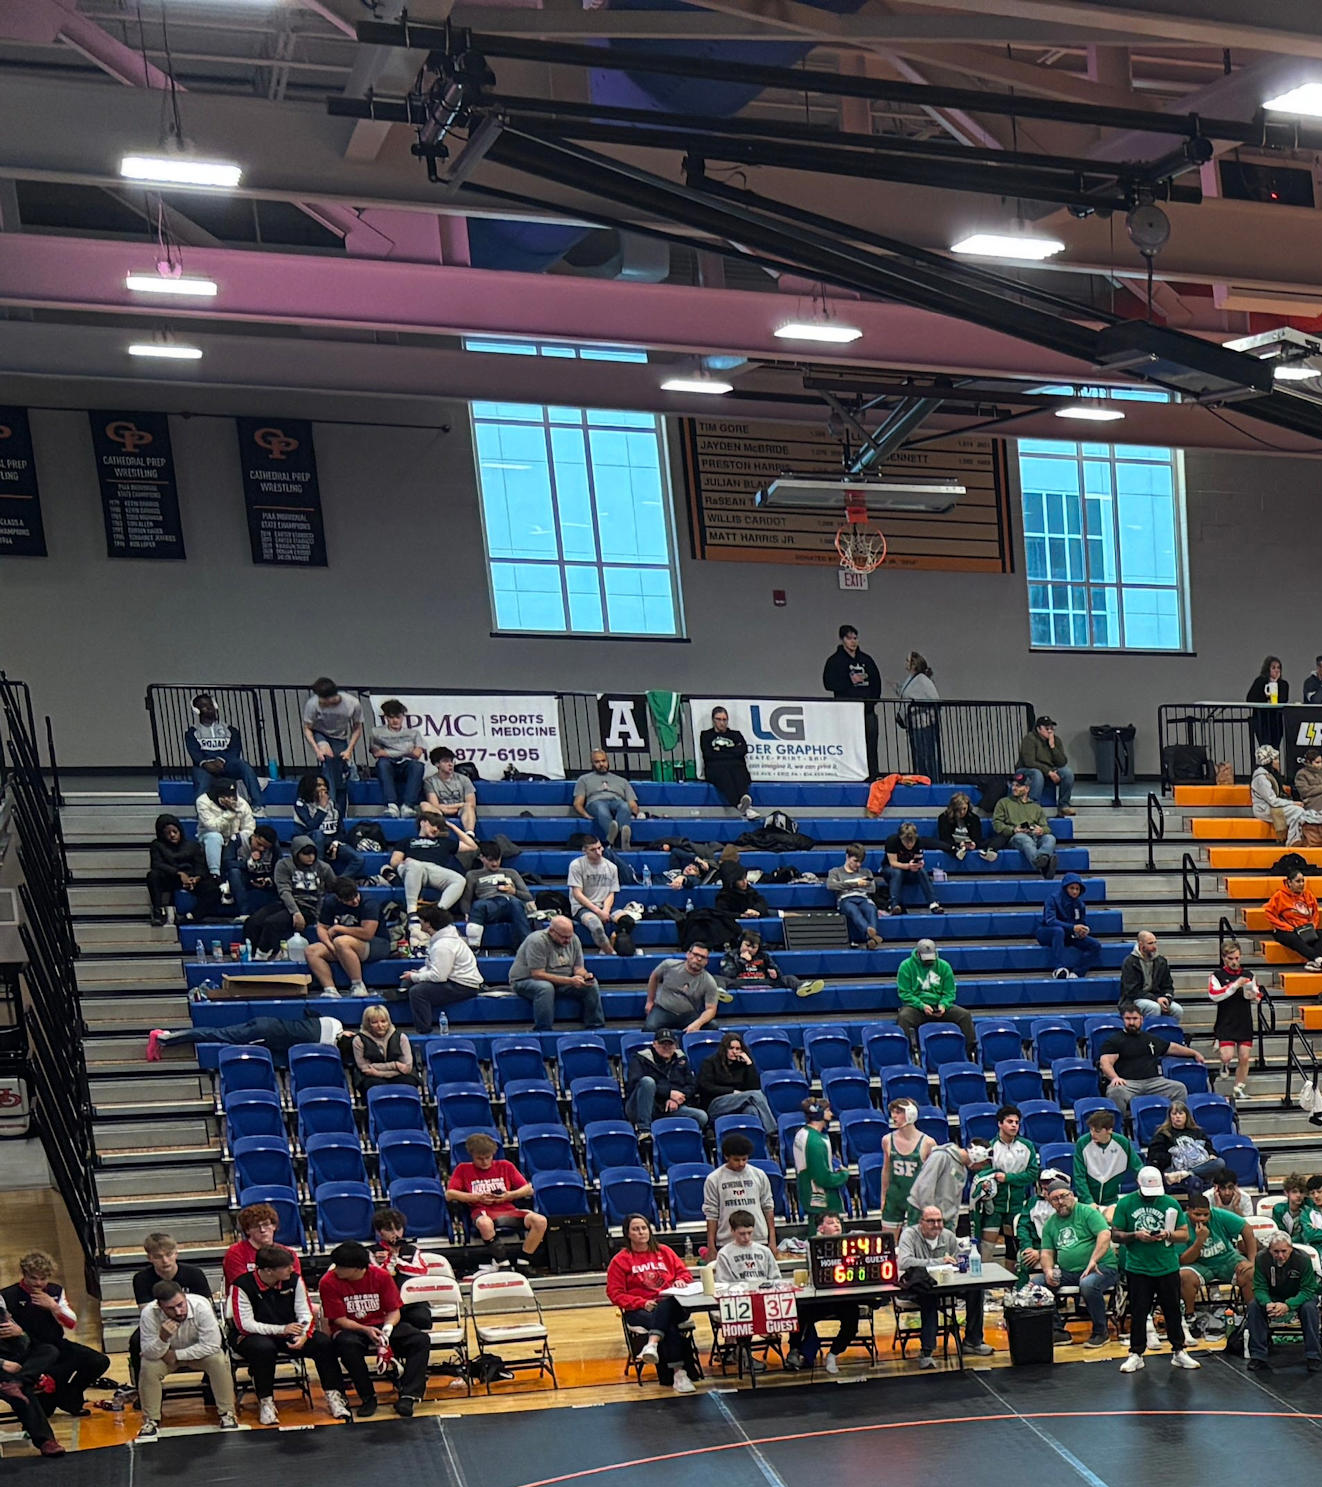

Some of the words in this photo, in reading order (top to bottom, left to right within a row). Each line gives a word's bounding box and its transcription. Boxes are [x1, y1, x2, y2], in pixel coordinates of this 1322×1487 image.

[699, 422, 717, 433] TIM
[719, 423, 749, 434] GORE
[700, 440, 741, 453] JAYDEN
[744, 443, 789, 455] McBRIDE
[702, 459, 751, 471] PRESTON
[704, 478, 741, 489] JULIAN
[705, 495, 750, 507] RaSEAN
[707, 513, 742, 524] WILLIS
[709, 532, 737, 543] MATT
[740, 533, 779, 544] HARRIS
[844, 572, 863, 587] EXIT
[490, 714, 545, 724] SPORTS
[605, 700, 644, 748] A
[750, 704, 806, 741] LG
[491, 727, 558, 737] MEDICINE
[775, 745, 844, 756] GRAPHICS
[892, 1159, 918, 1178] SF
[842, 1237, 882, 1257] 1:41
[820, 1258, 842, 1268] HOME
[864, 1255, 889, 1264] GUEST
[833, 1264, 846, 1284] 6
[880, 1261, 893, 1281] 0
[724, 1301, 752, 1321] 12
[766, 1297, 796, 1317] 37
[721, 1322, 755, 1338] HOME
[766, 1319, 800, 1335] GUEST
